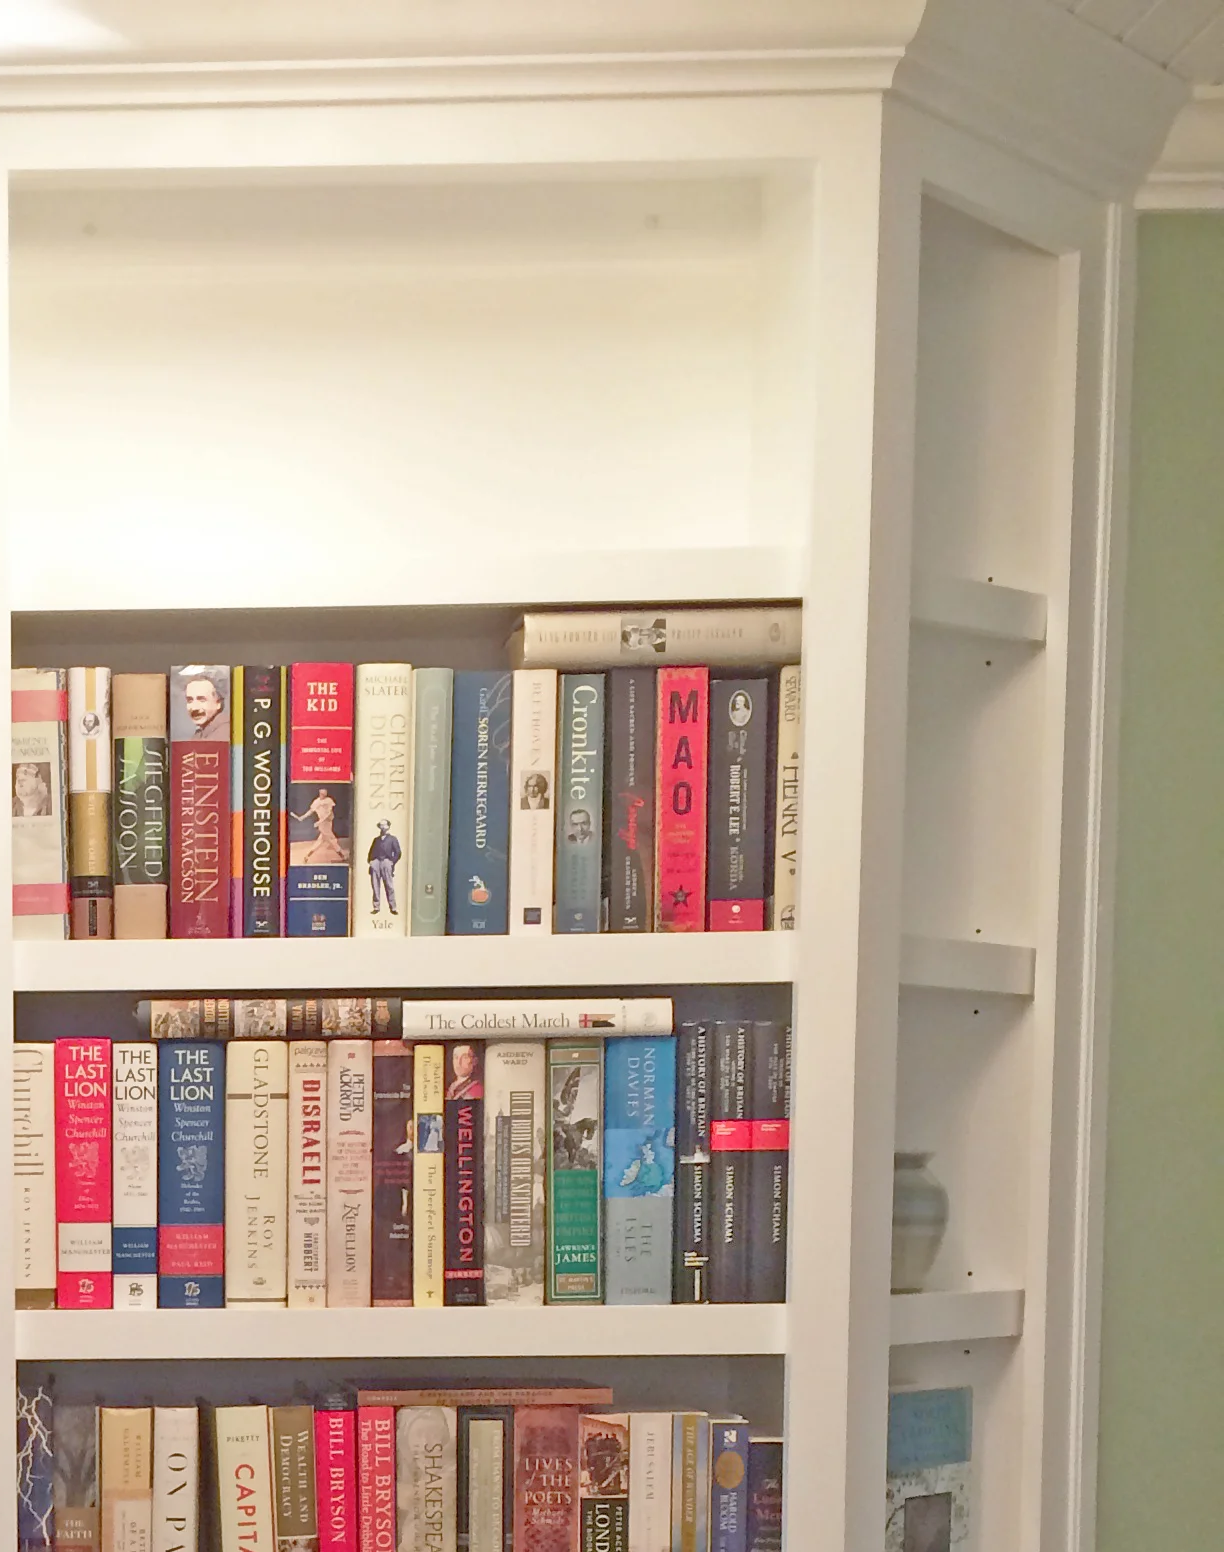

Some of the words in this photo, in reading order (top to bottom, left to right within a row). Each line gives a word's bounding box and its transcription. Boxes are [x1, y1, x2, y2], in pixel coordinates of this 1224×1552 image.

[254, 698, 270, 713] P.
[307, 683, 337, 694] THE
[307, 699, 338, 711] KID
[254, 722, 271, 744] G.
[570, 685, 598, 801] Cronkite
[668, 690, 698, 816] MAO
[182, 752, 194, 816] WALTER
[370, 715, 386, 811] DICKENS
[389, 714, 405, 812] CHARLES
[119, 758, 138, 870] SASSOON
[143, 745, 163, 877] SIEGFRIED
[194, 751, 219, 902] EINSTEIN
[253, 750, 271, 898] WODEHOUSE
[476, 762, 488, 849] KIERKEGAARD
[182, 822, 195, 903] ISAACSON
[372, 920, 393, 929] Yale
[425, 1014, 456, 1029] The
[461, 1014, 516, 1029] Coldest
[521, 1013, 570, 1028] March
[65, 1065, 107, 1079] LAST
[69, 1046, 102, 1061] THE
[116, 1069, 156, 1082] LAST
[119, 1050, 151, 1064] THE
[171, 1069, 214, 1082] LAST
[175, 1050, 208, 1064] THE
[65, 1082, 107, 1096] LION
[115, 1086, 156, 1100] LION
[171, 1086, 214, 1100] LION
[627, 1057, 639, 1117] DAVIES
[644, 1047, 655, 1126] NORMAN
[253, 1048, 269, 1179] GLADSTONE
[302, 1079, 322, 1184] DISRAELI
[458, 1106, 473, 1263] WELLINGTON
[555, 1252, 596, 1264] JAMES
[328, 1418, 344, 1460] BILL
[375, 1419, 390, 1467] BILL
[330, 1467, 346, 1543] BRYSON
